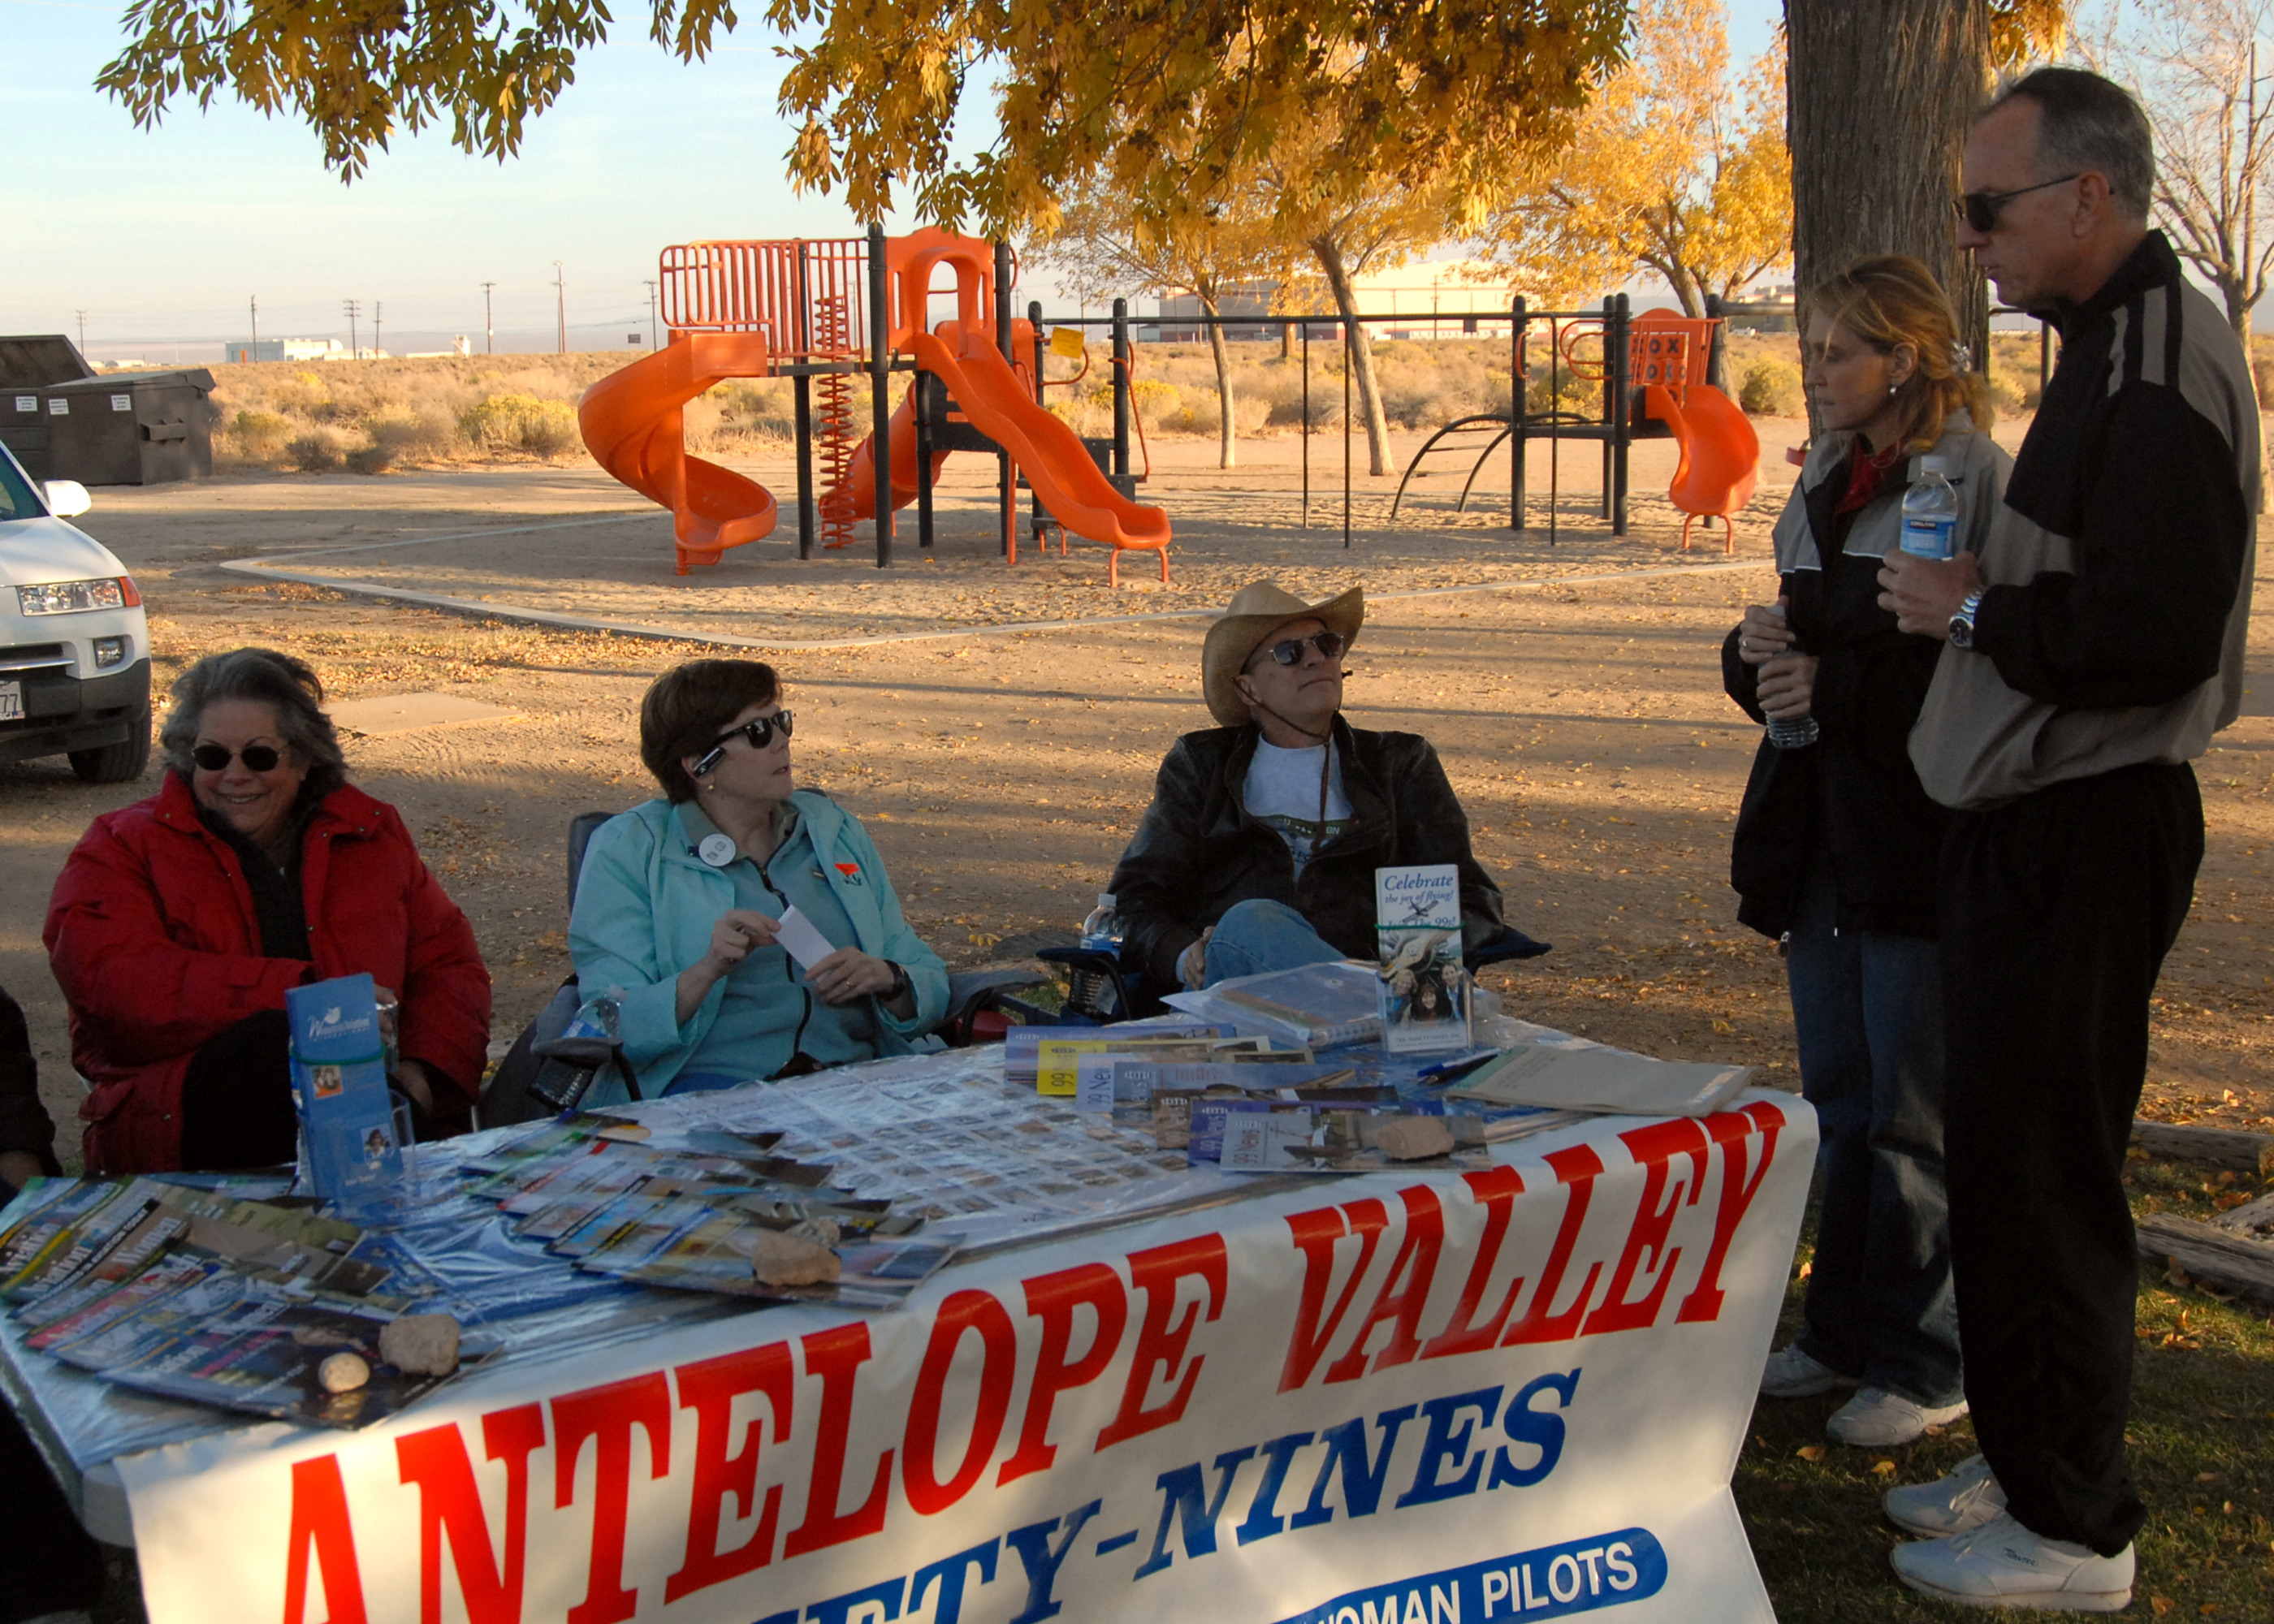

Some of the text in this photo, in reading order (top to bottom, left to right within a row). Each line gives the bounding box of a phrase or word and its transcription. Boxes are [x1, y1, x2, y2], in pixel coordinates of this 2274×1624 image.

[1385, 873, 1454, 891] Celebrate
[1386, 890, 1455, 905] the joy of flying!
[281, 1100, 1788, 1624] ANTELOPE VALLEY
[1482, 1541, 1639, 1619] PILOTS
